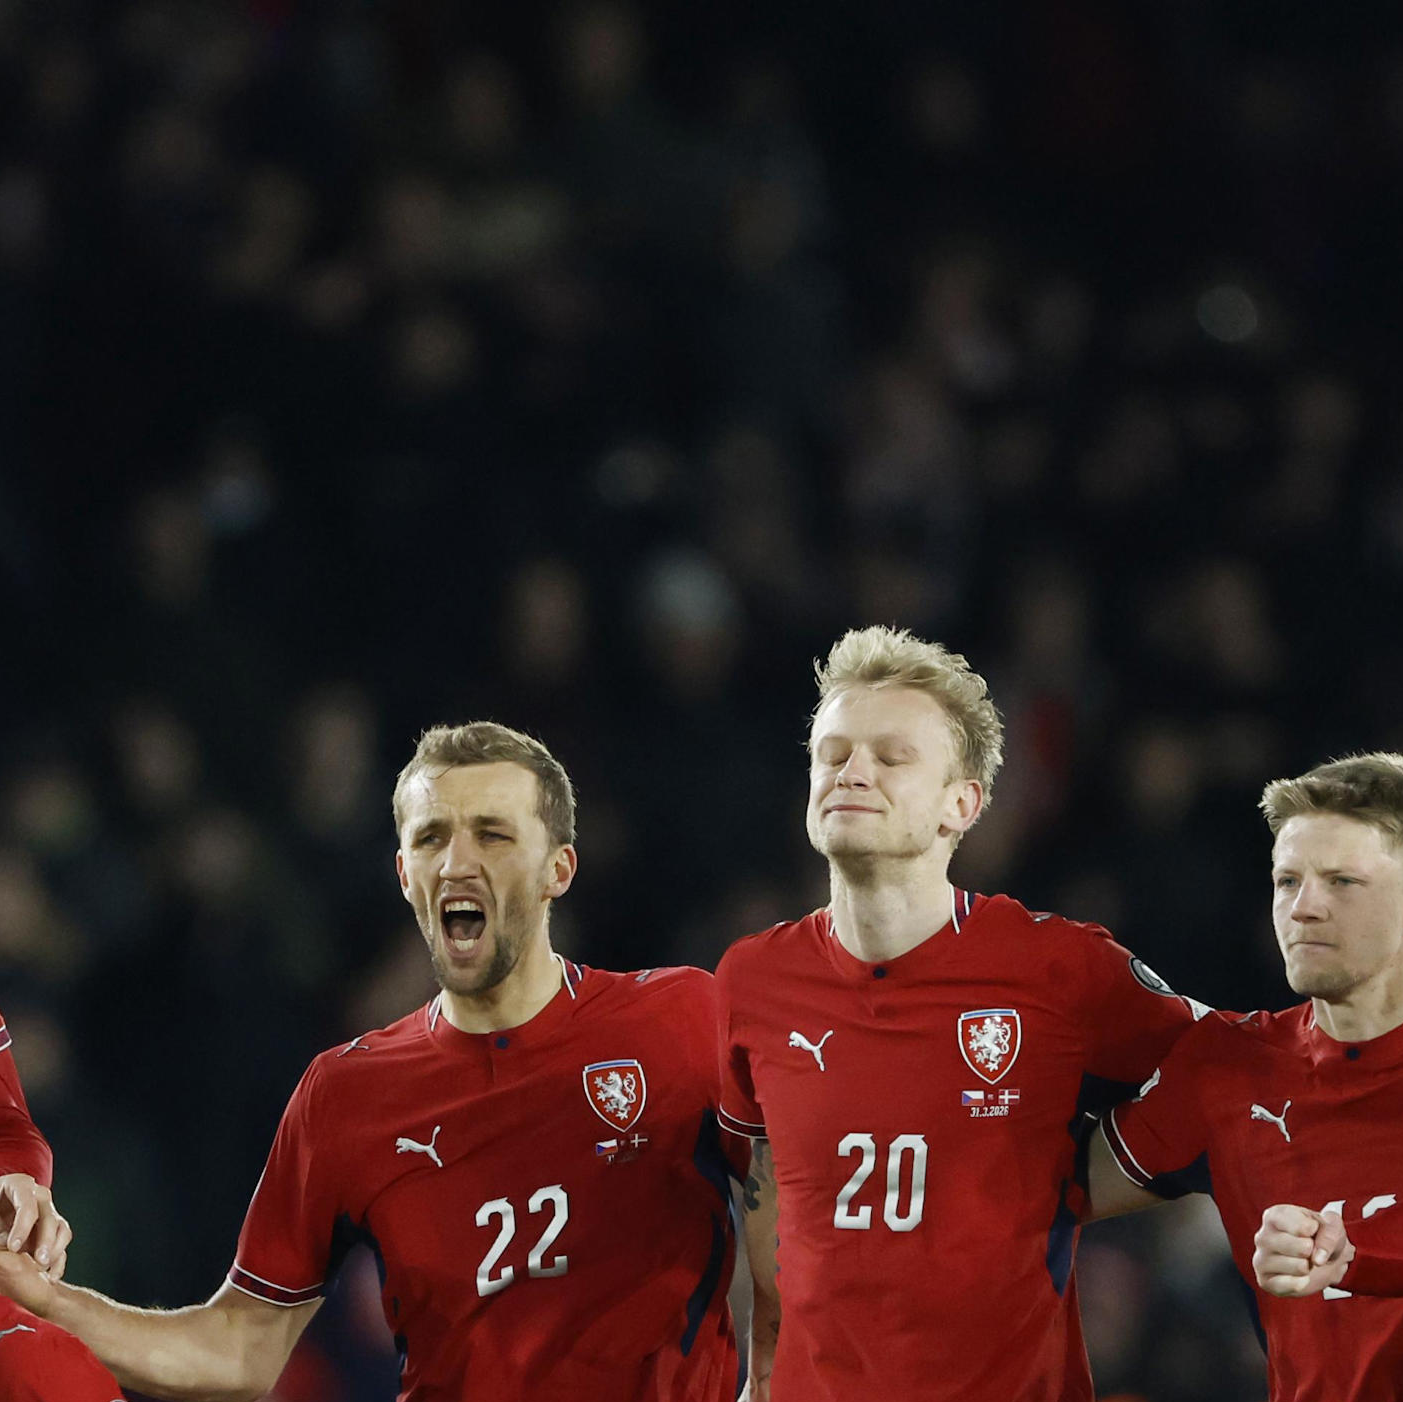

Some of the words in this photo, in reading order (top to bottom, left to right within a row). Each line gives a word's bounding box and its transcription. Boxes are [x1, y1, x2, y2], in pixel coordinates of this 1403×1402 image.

[970, 1105, 1010, 1118] 31.3.2026
[833, 1132, 928, 1232] 20
[474, 1184, 569, 1298] 22
